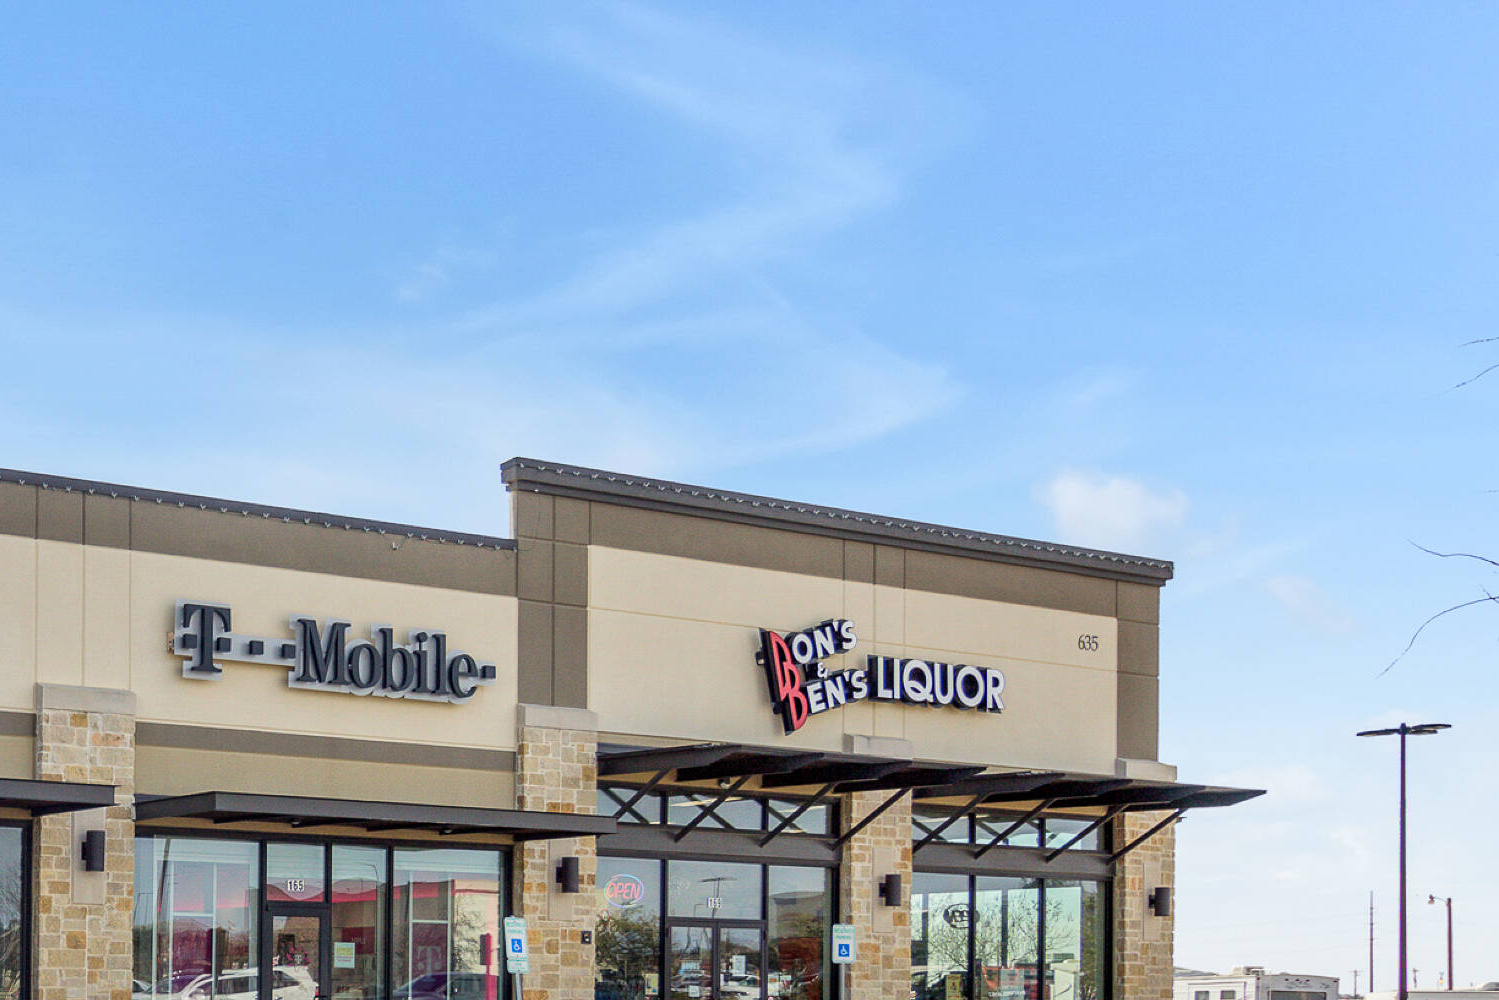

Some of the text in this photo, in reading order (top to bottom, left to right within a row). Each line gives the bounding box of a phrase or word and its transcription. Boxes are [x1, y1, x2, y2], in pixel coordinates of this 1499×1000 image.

[1078, 634, 1099, 651] 635
[769, 621, 858, 701] DON'S
[817, 661, 829, 678] &
[784, 656, 1005, 730] BEN'S LIQUOR
[288, 880, 304, 891] 165
[605, 881, 640, 900] OPEN
